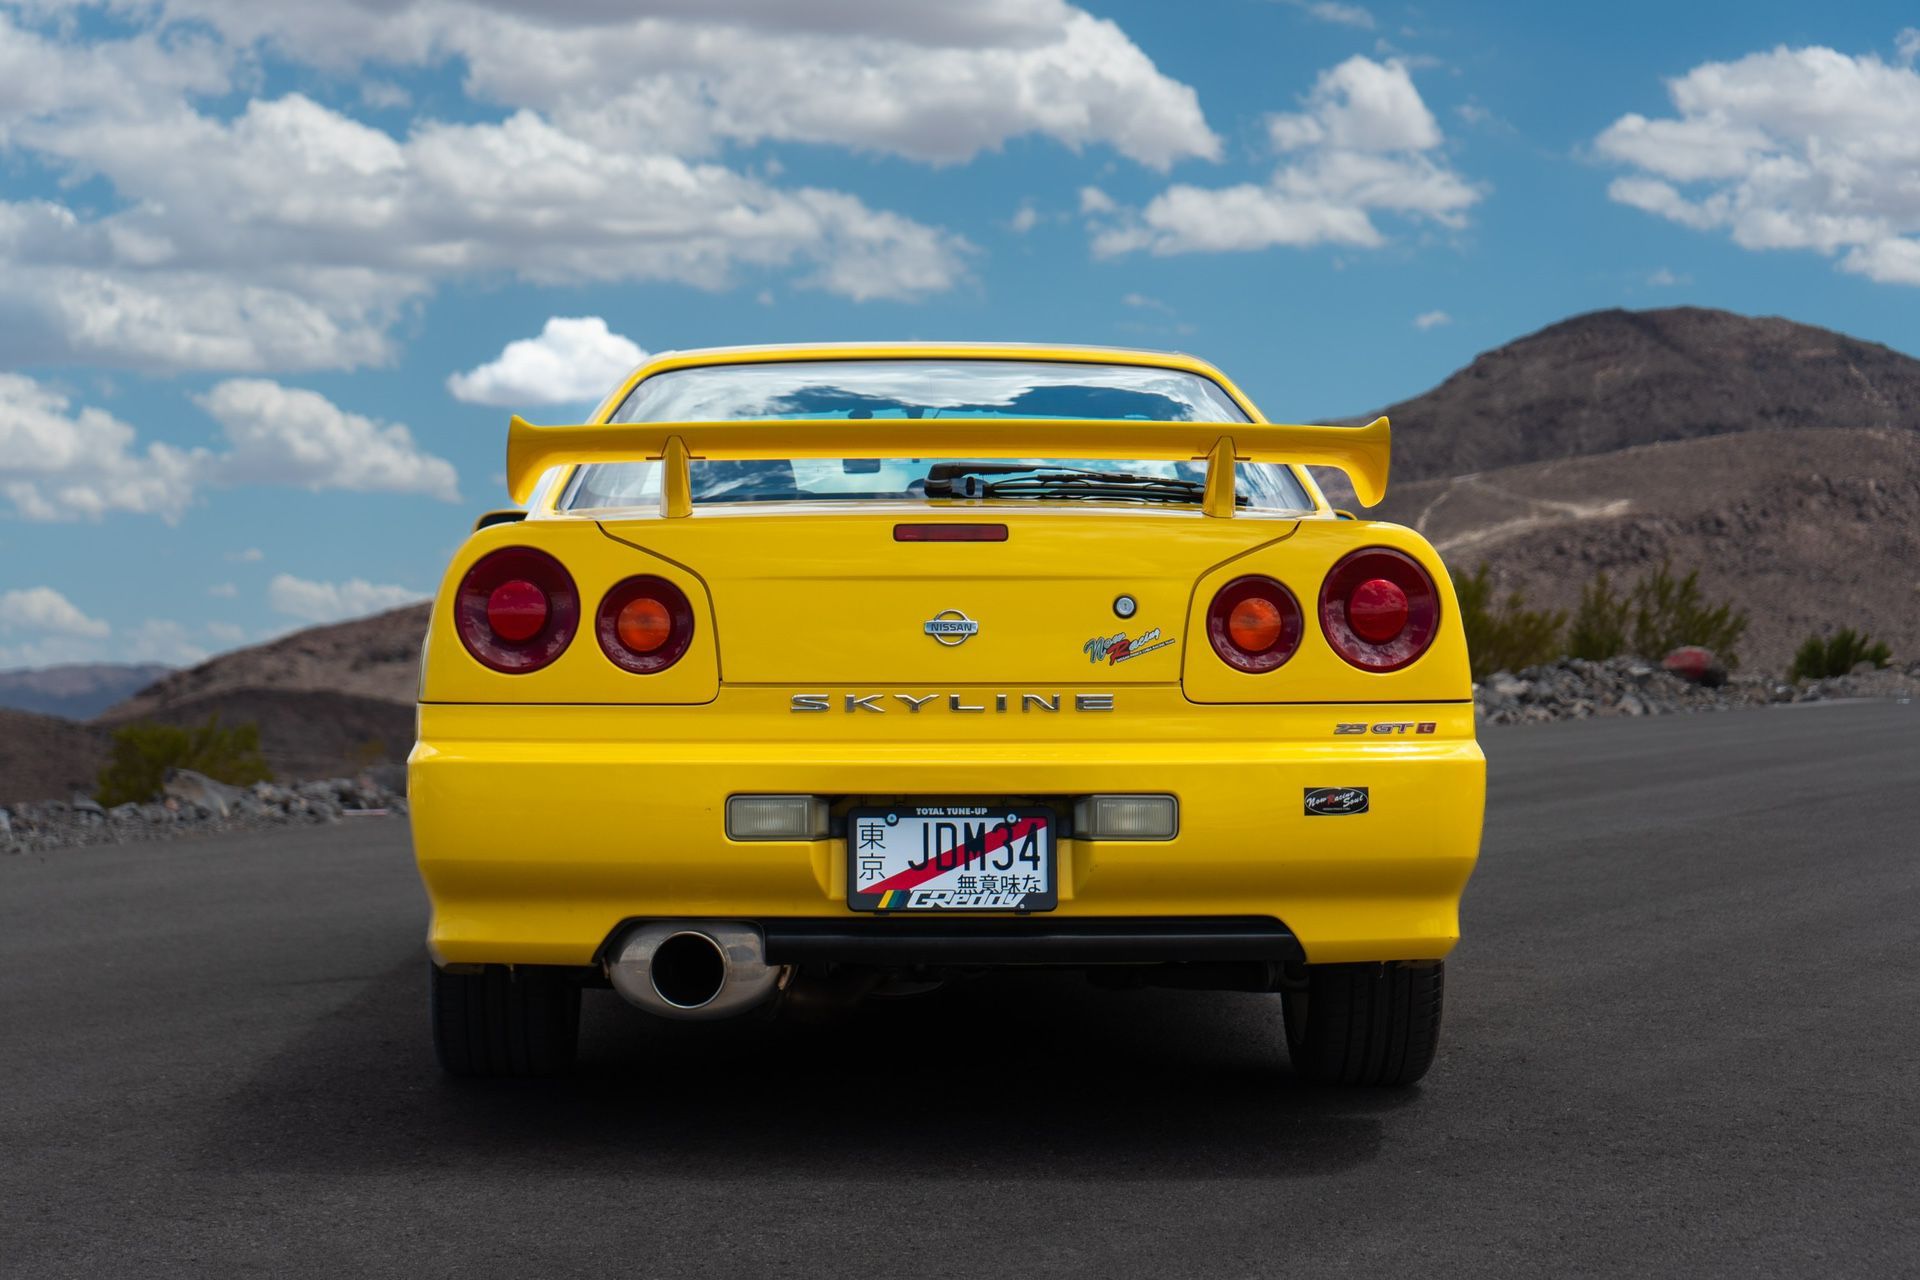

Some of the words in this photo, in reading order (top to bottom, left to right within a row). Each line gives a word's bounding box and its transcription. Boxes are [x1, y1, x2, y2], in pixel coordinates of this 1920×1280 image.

[931, 623, 972, 631] NISSAN
[1106, 627, 1161, 667] Racing
[790, 693, 1114, 713] SKYLINE
[1327, 791, 1355, 805] Racing
[1342, 794, 1364, 808] Soul
[916, 807, 945, 815] TOTAL
[947, 807, 988, 815] TUNE-UP
[858, 822, 886, 880] 東京
[907, 822, 1041, 871] JDM34
